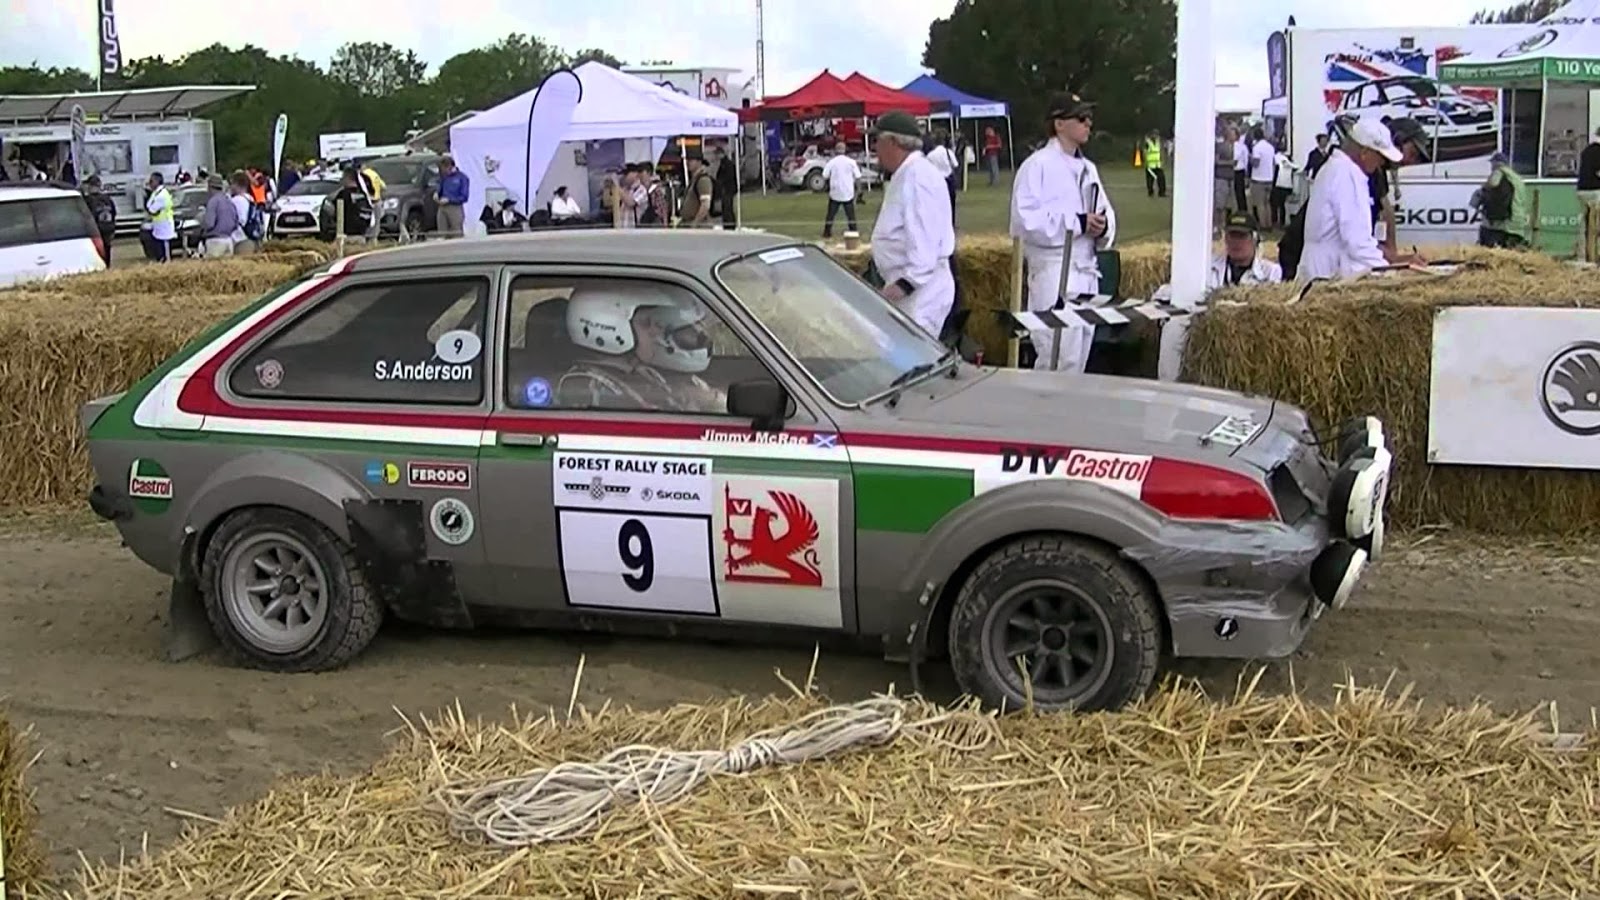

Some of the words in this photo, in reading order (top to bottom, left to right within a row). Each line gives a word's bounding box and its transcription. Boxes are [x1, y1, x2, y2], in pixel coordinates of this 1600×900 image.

[1557, 60, 1579, 75] 110
[453, 338, 463, 355] 9
[375, 360, 473, 380] S.Anderson
[700, 429, 752, 445] Jimmy
[755, 431, 808, 445] McRae
[559, 457, 611, 471] FOREST
[614, 459, 658, 474] RALLY
[662, 461, 707, 476] STAGE
[1001, 448, 1063, 475] DTV
[1066, 453, 1150, 482] Castrol
[411, 468, 467, 482] FERODO
[132, 478, 171, 495] Castrol
[732, 501, 749, 514] V
[618, 518, 654, 593] 9
